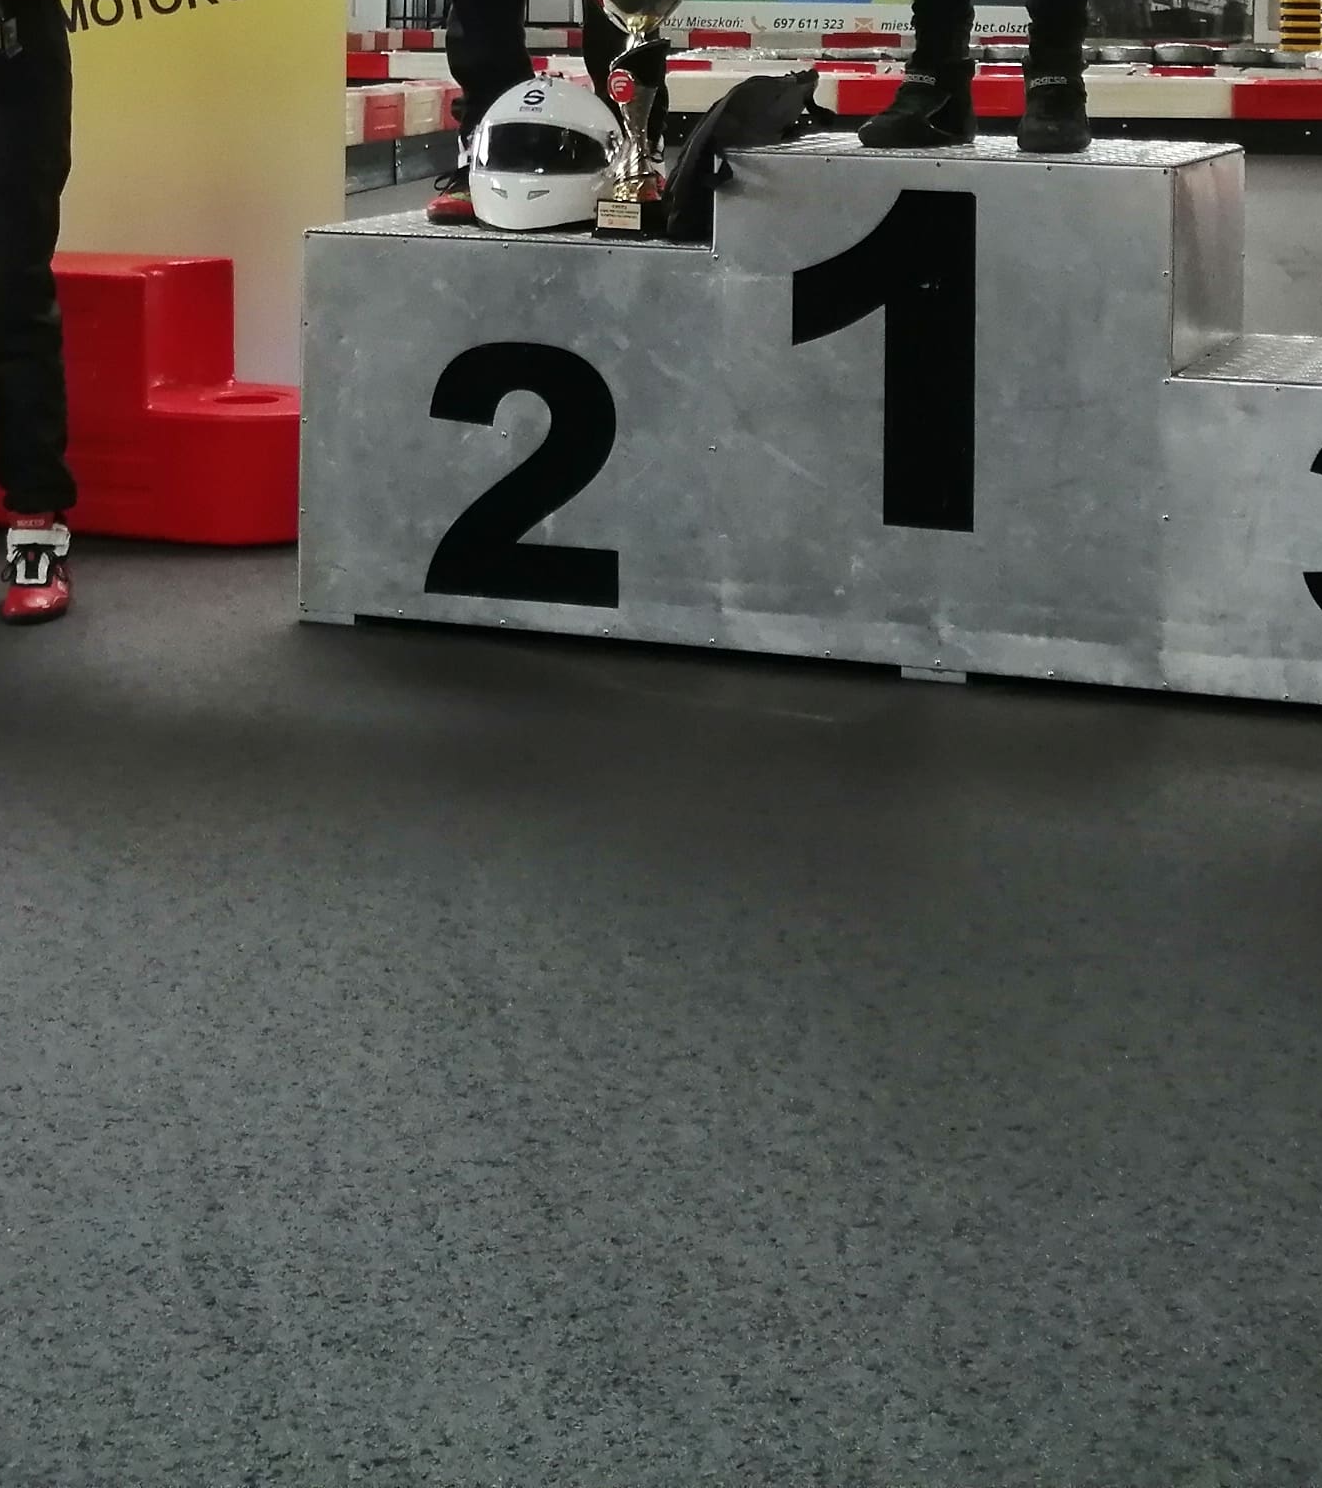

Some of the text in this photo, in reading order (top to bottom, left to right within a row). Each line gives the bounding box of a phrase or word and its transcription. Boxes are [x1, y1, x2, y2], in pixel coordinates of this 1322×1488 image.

[773, 18, 796, 30] 697
[798, 18, 819, 30] 611
[824, 18, 844, 30] 323
[423, 341, 620, 609] 2
[791, 188, 977, 533] 1
